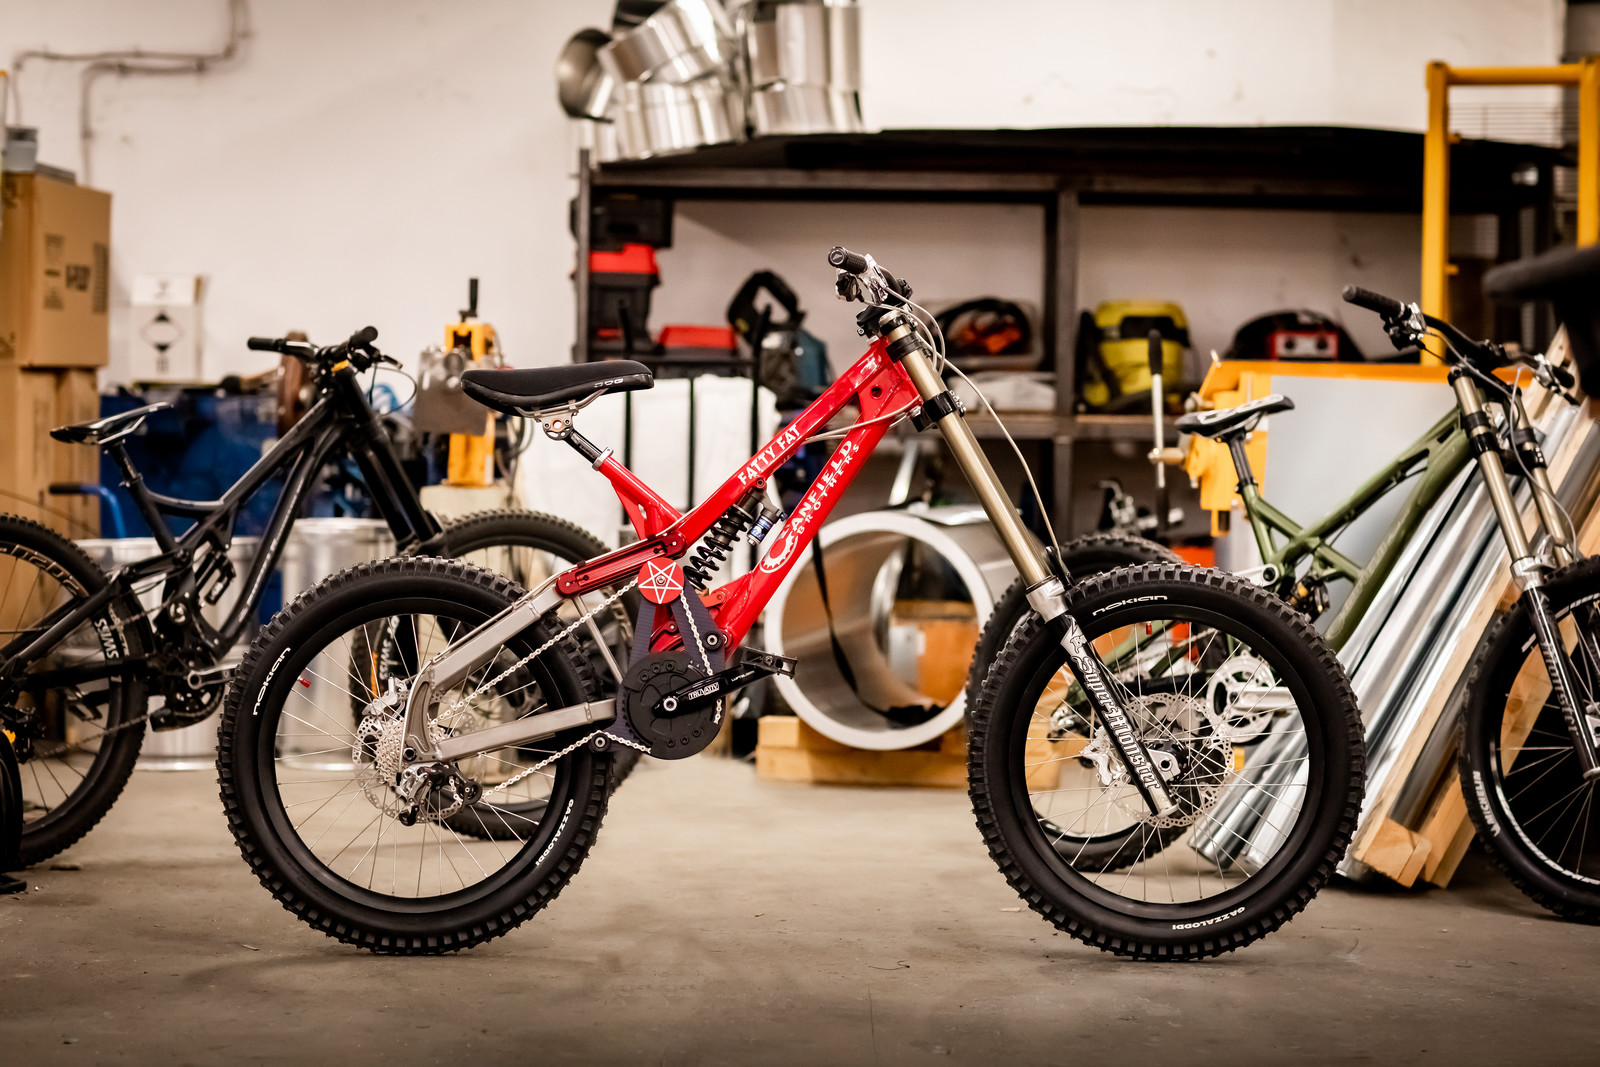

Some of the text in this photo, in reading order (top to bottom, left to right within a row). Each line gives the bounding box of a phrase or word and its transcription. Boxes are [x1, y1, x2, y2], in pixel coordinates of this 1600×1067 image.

[737, 423, 801, 486] FATTY FAT
[797, 443, 860, 535] BROTHERS
[688, 682, 720, 700] TRUVATIV
[1472, 769, 1498, 826] MICHELIN
[535, 798, 575, 867] GAZZALODDI
[1171, 905, 1247, 931] GAZZALODDI
